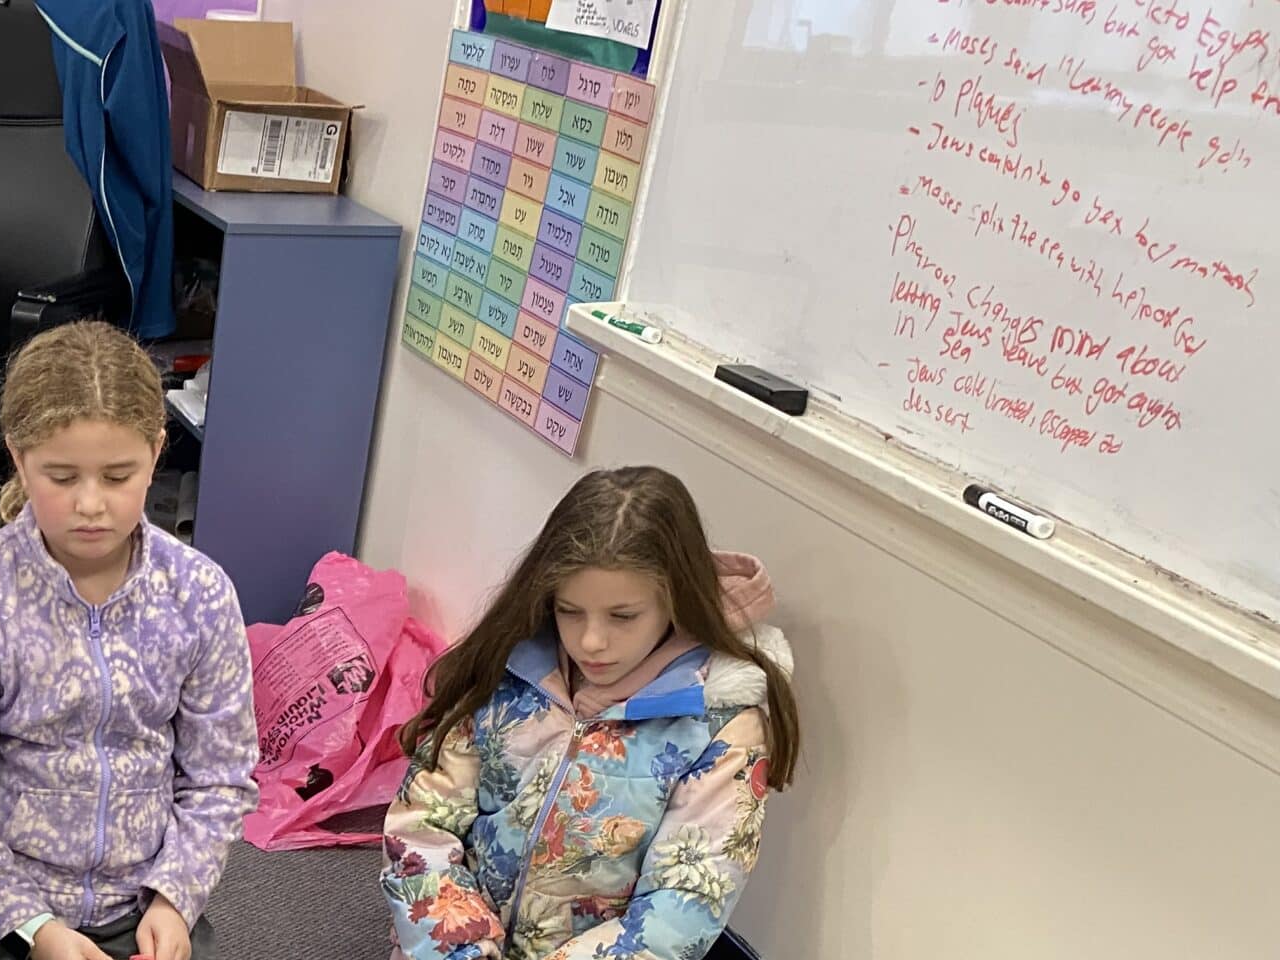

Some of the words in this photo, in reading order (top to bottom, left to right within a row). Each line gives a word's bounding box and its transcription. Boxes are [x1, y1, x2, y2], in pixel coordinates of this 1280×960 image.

[1189, 53, 1237, 109] help
[1134, 103, 1192, 152] people
[927, 122, 974, 157] Jews
[1052, 179, 1080, 206] go
[1012, 214, 1037, 247] the
[907, 356, 947, 386] Jews
